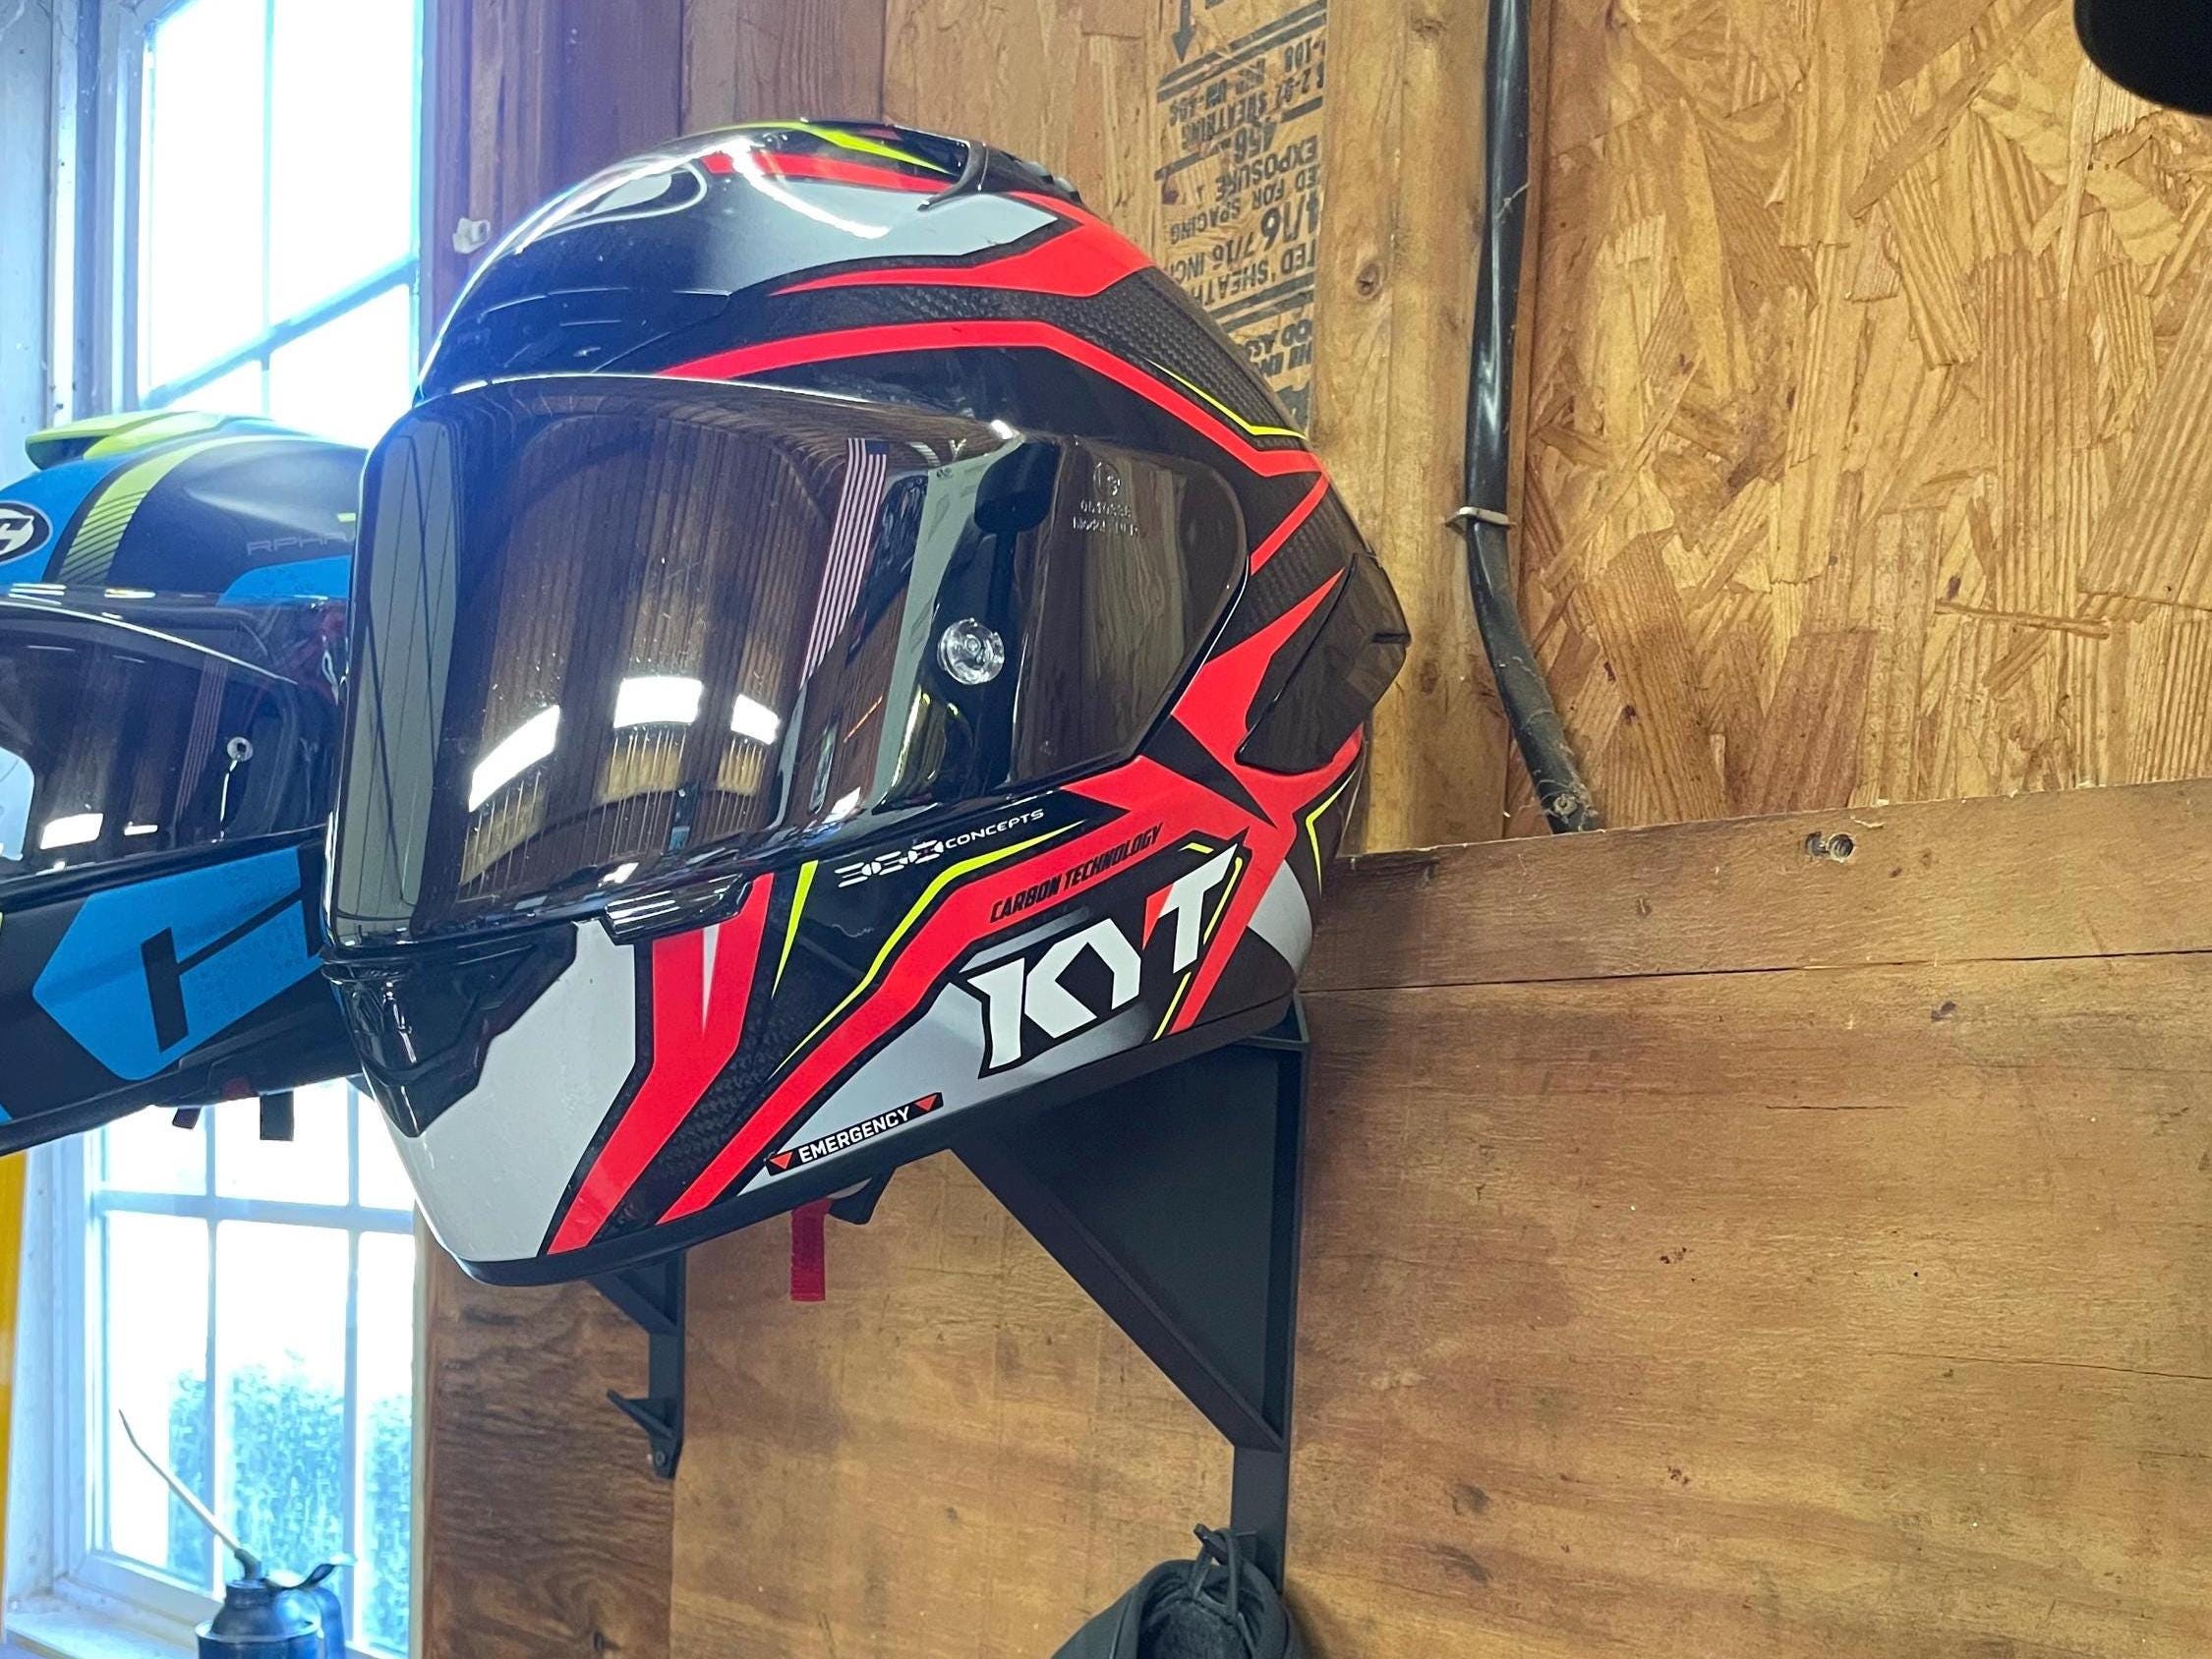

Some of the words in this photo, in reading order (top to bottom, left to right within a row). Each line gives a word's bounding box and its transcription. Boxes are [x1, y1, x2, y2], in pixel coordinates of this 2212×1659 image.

[1285, 37, 1325, 73] -108
[1215, 134, 1318, 201] EXPOSURE
[1252, 178, 1284, 211] FOR
[1170, 197, 1241, 246] SPACING
[1212, 231, 1255, 270] 7/16
[945, 808, 1045, 850] CONCEPTS
[989, 873, 1063, 924] CARBON
[1063, 821, 1164, 891] TECHNOLOGY
[966, 842, 1239, 1070] KYT
[797, 1106, 910, 1164] EMERGENCY
